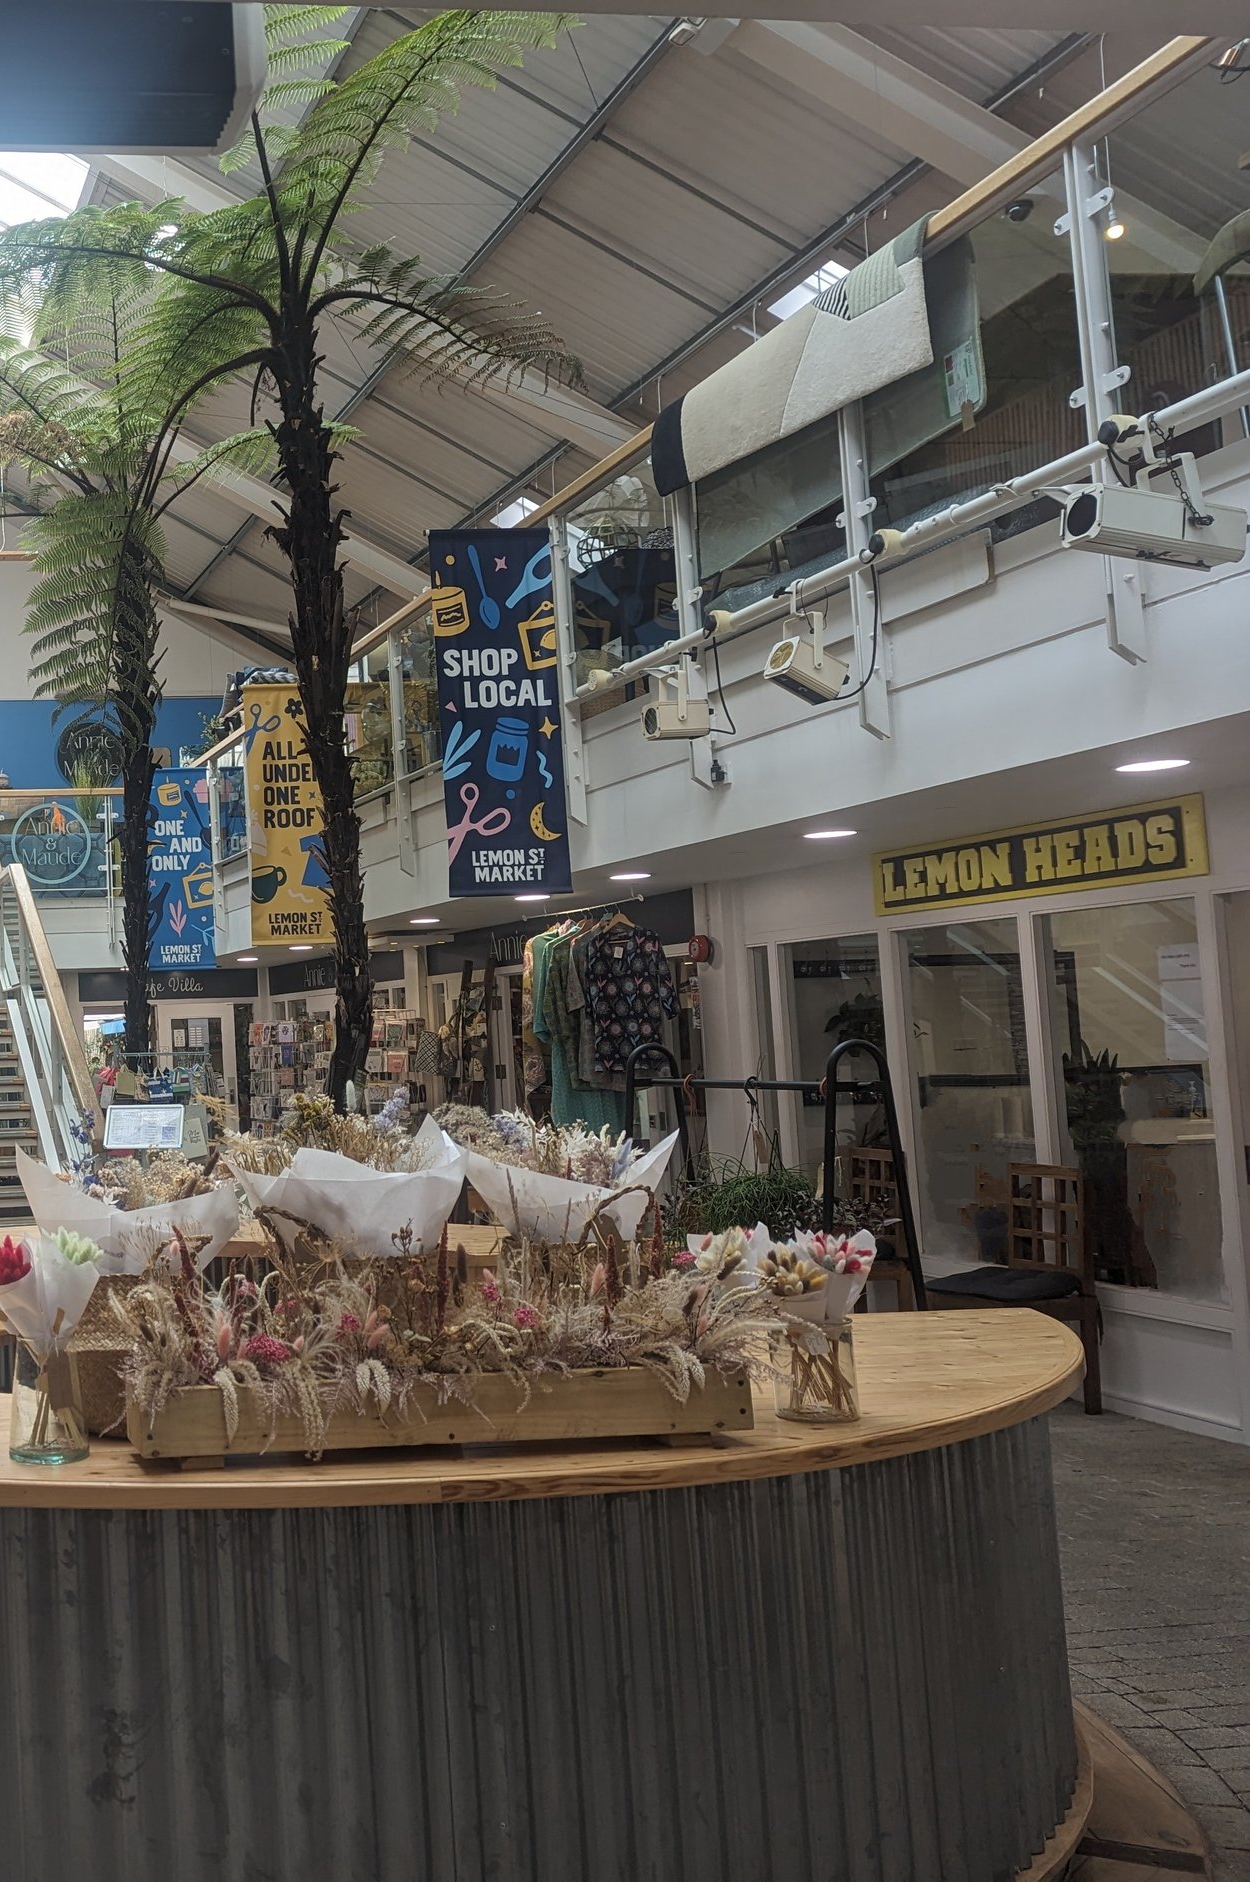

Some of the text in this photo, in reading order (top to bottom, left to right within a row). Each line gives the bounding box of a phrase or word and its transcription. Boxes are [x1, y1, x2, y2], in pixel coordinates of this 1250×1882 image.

[443, 649, 518, 677] SHOP
[463, 680, 552, 709] LOCAL
[262, 741, 298, 761] ALL
[63, 758, 120, 777] Mde
[263, 785, 301, 806] ONE
[263, 807, 316, 829] ROOF
[154, 820, 185, 836] ONE
[45, 837, 57, 851] &
[169, 837, 202, 853] AND
[22, 846, 83, 866] Maude
[151, 854, 191, 872] ONLY
[472, 848, 525, 867] LEMON
[882, 814, 1179, 902] LEMON HEADS
[474, 865, 545, 883] MARKET
[268, 912, 307, 925] LEMON
[271, 923, 322, 936] MARKET
[160, 945, 189, 955] LEMON
[490, 930, 527, 962] Annie
[162, 953, 201, 964] MARKET
[168, 977, 204, 992] Villa
